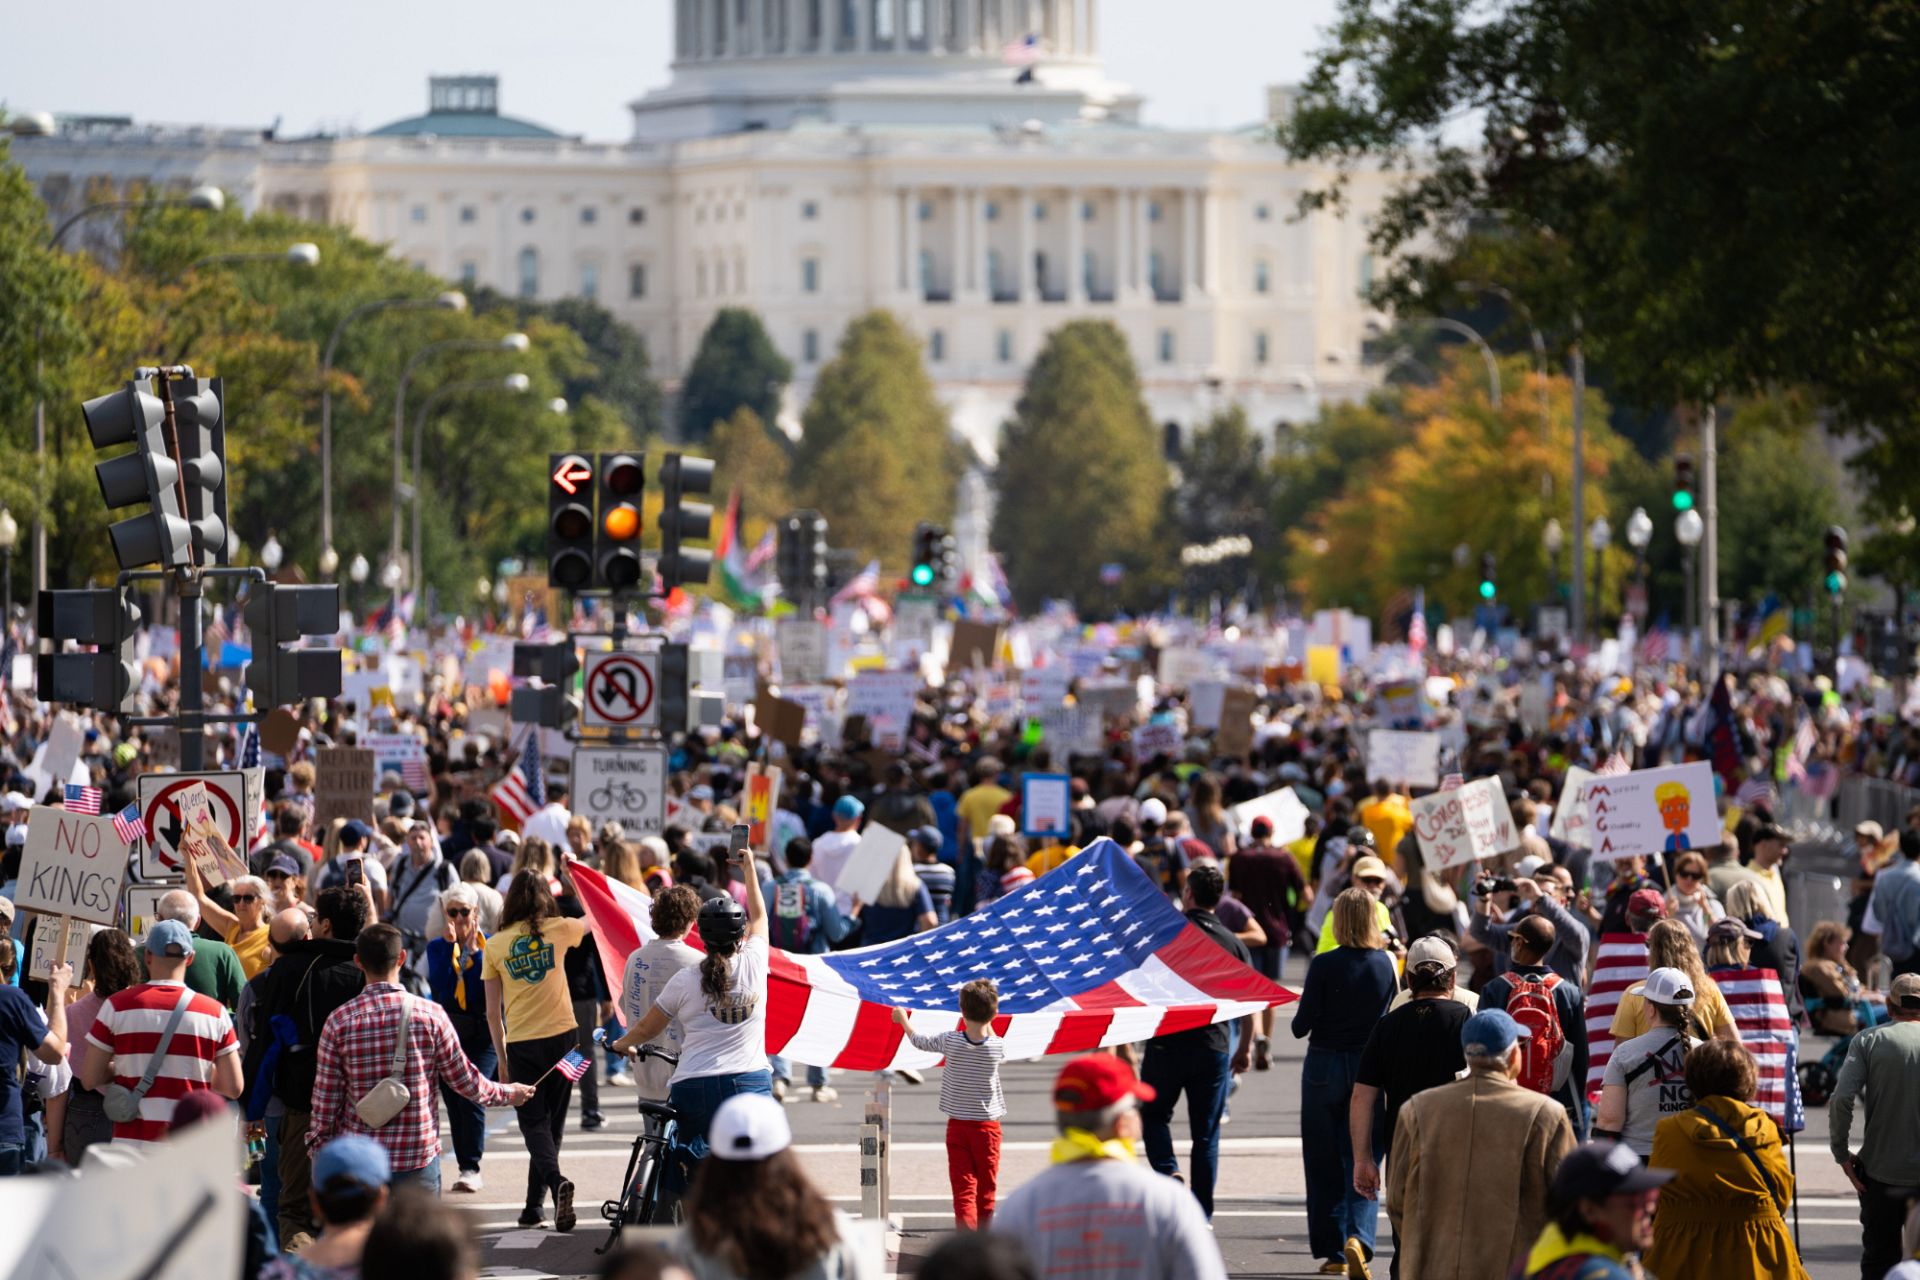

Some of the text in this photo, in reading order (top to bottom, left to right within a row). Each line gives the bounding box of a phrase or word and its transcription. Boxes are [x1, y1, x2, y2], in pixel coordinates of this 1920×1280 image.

[592, 757, 647, 775] TURNING
[180, 790, 207, 813] Queers
[54, 817, 100, 858] NO
[189, 839, 209, 860] NOT
[29, 861, 116, 912] KINGS
[628, 957, 650, 1018] all things go
[1660, 1085, 1691, 1102] NO
[1659, 1102, 1689, 1113] KING
